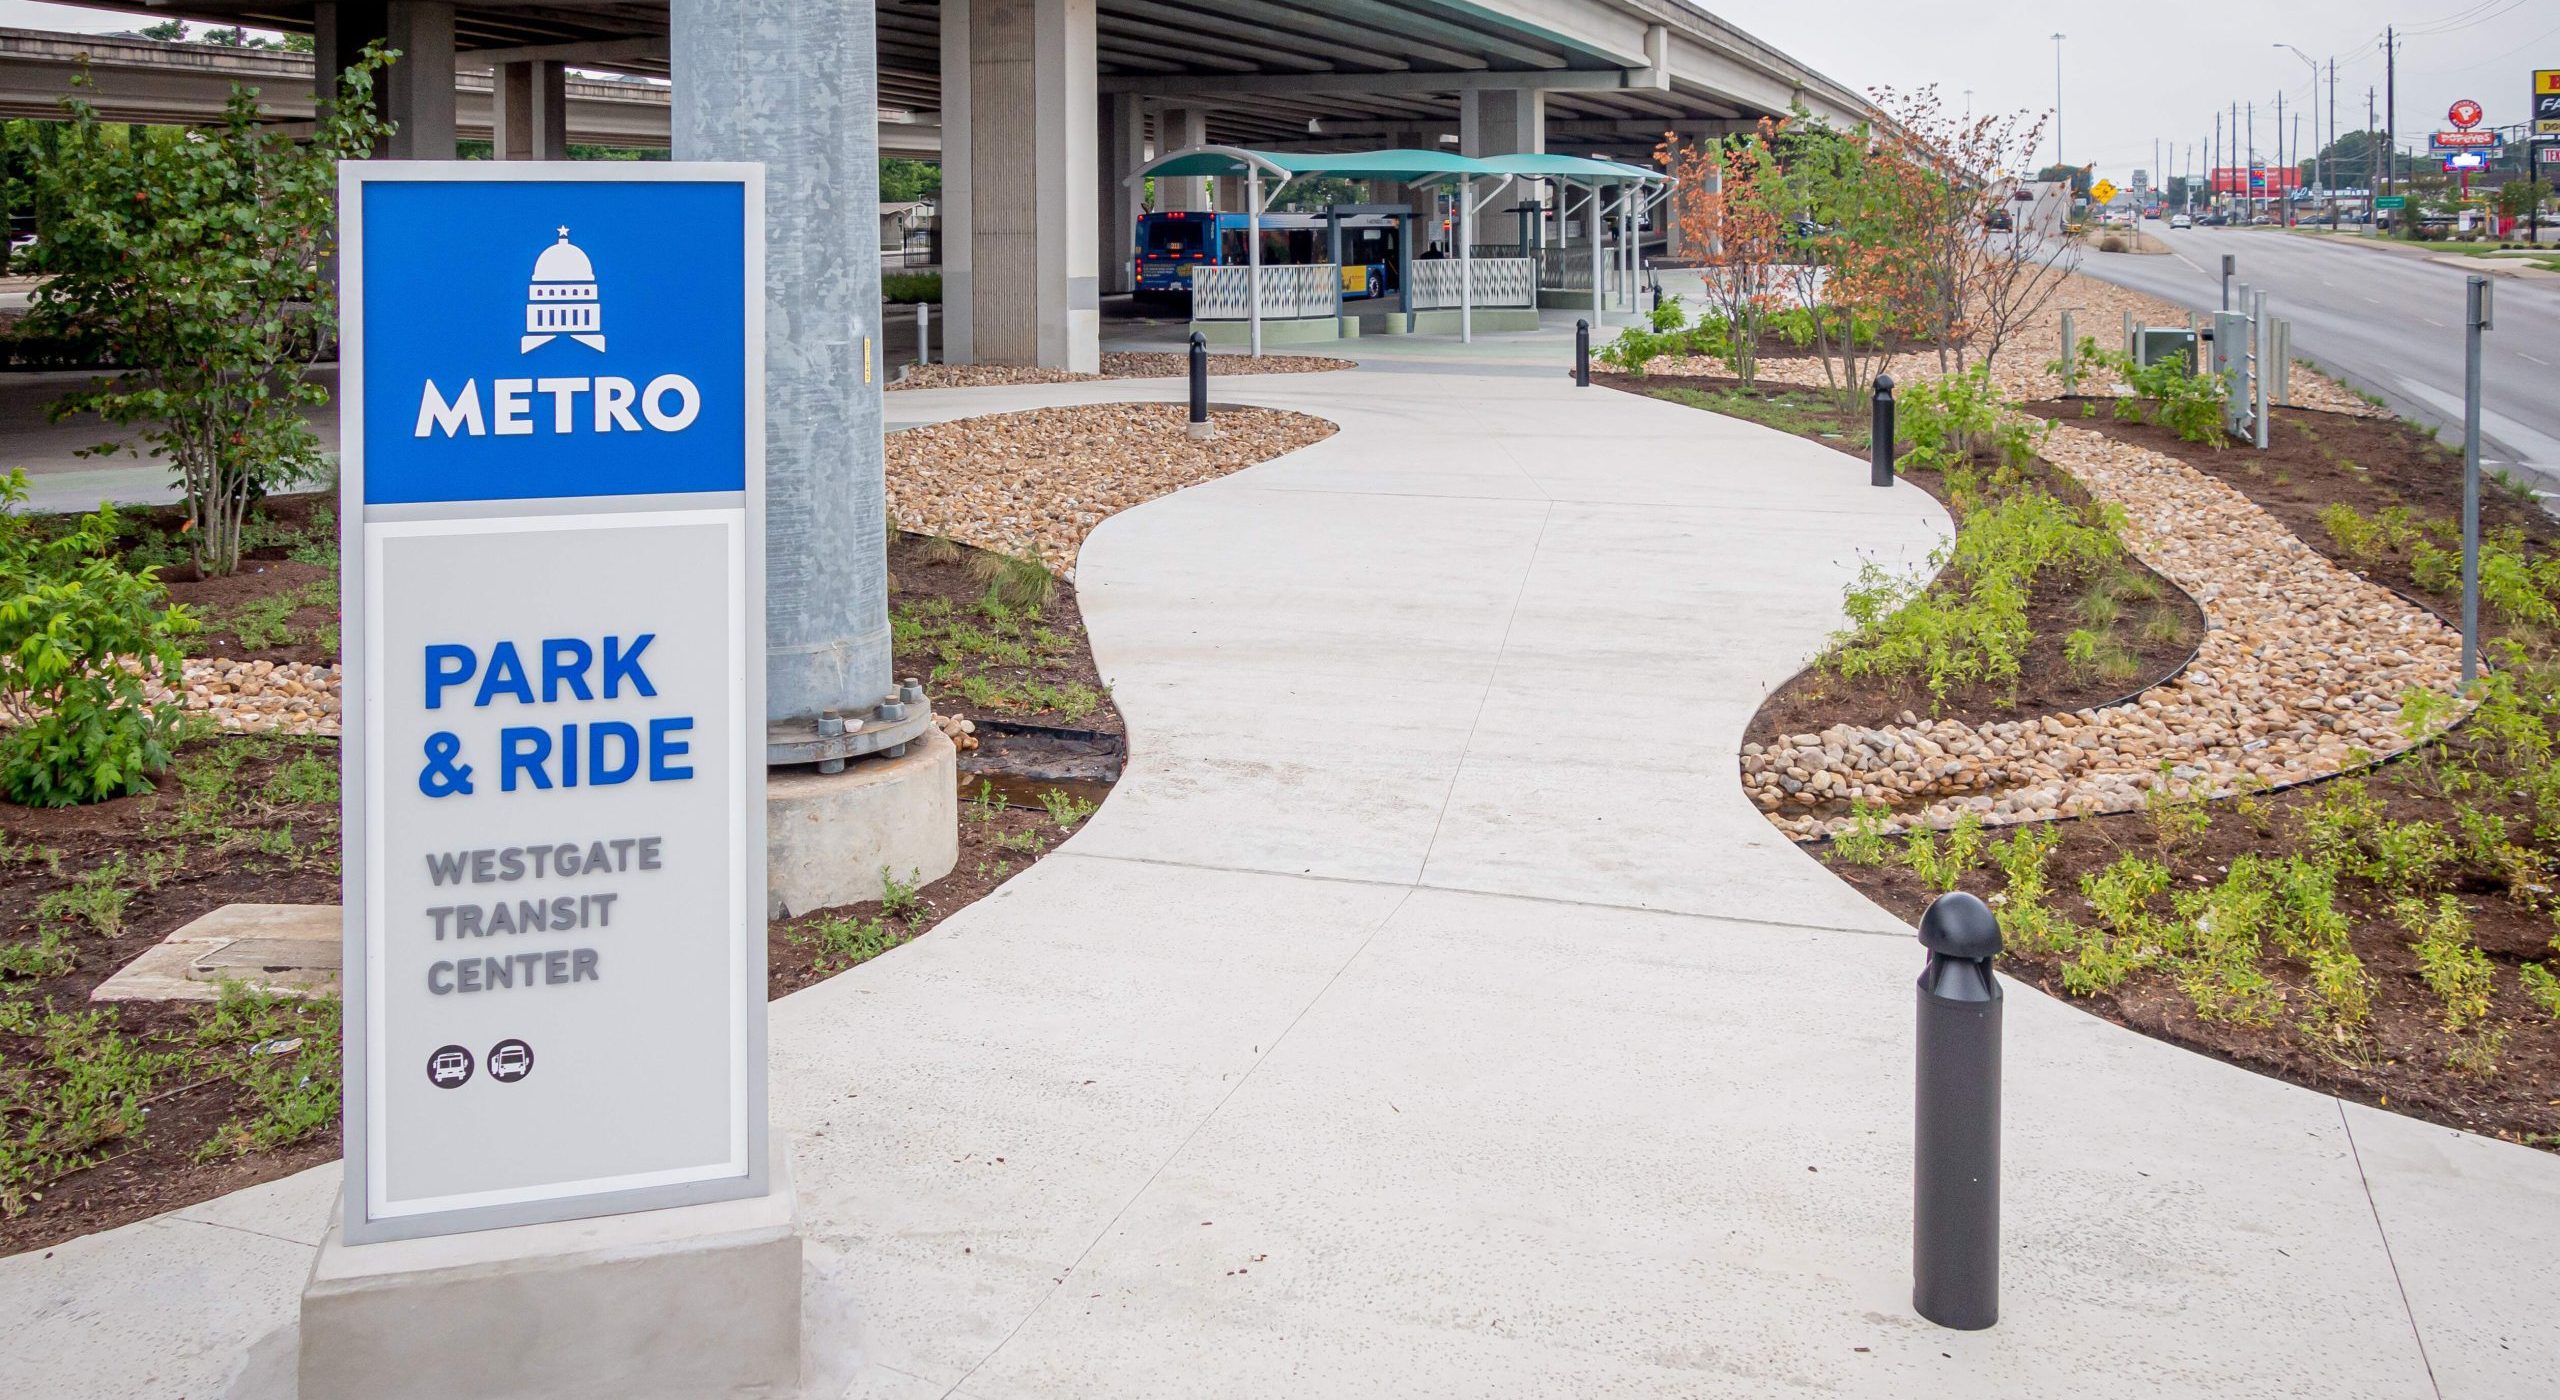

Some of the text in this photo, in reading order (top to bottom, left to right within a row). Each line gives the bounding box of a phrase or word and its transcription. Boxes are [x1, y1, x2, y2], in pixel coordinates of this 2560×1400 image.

[414, 373, 701, 439] METRO
[425, 633, 658, 709] PARK
[418, 716, 694, 798] & RIDE
[425, 835, 662, 887] WESTGATE
[425, 892, 618, 941] TRANSIT
[427, 947, 600, 996] CENTER
